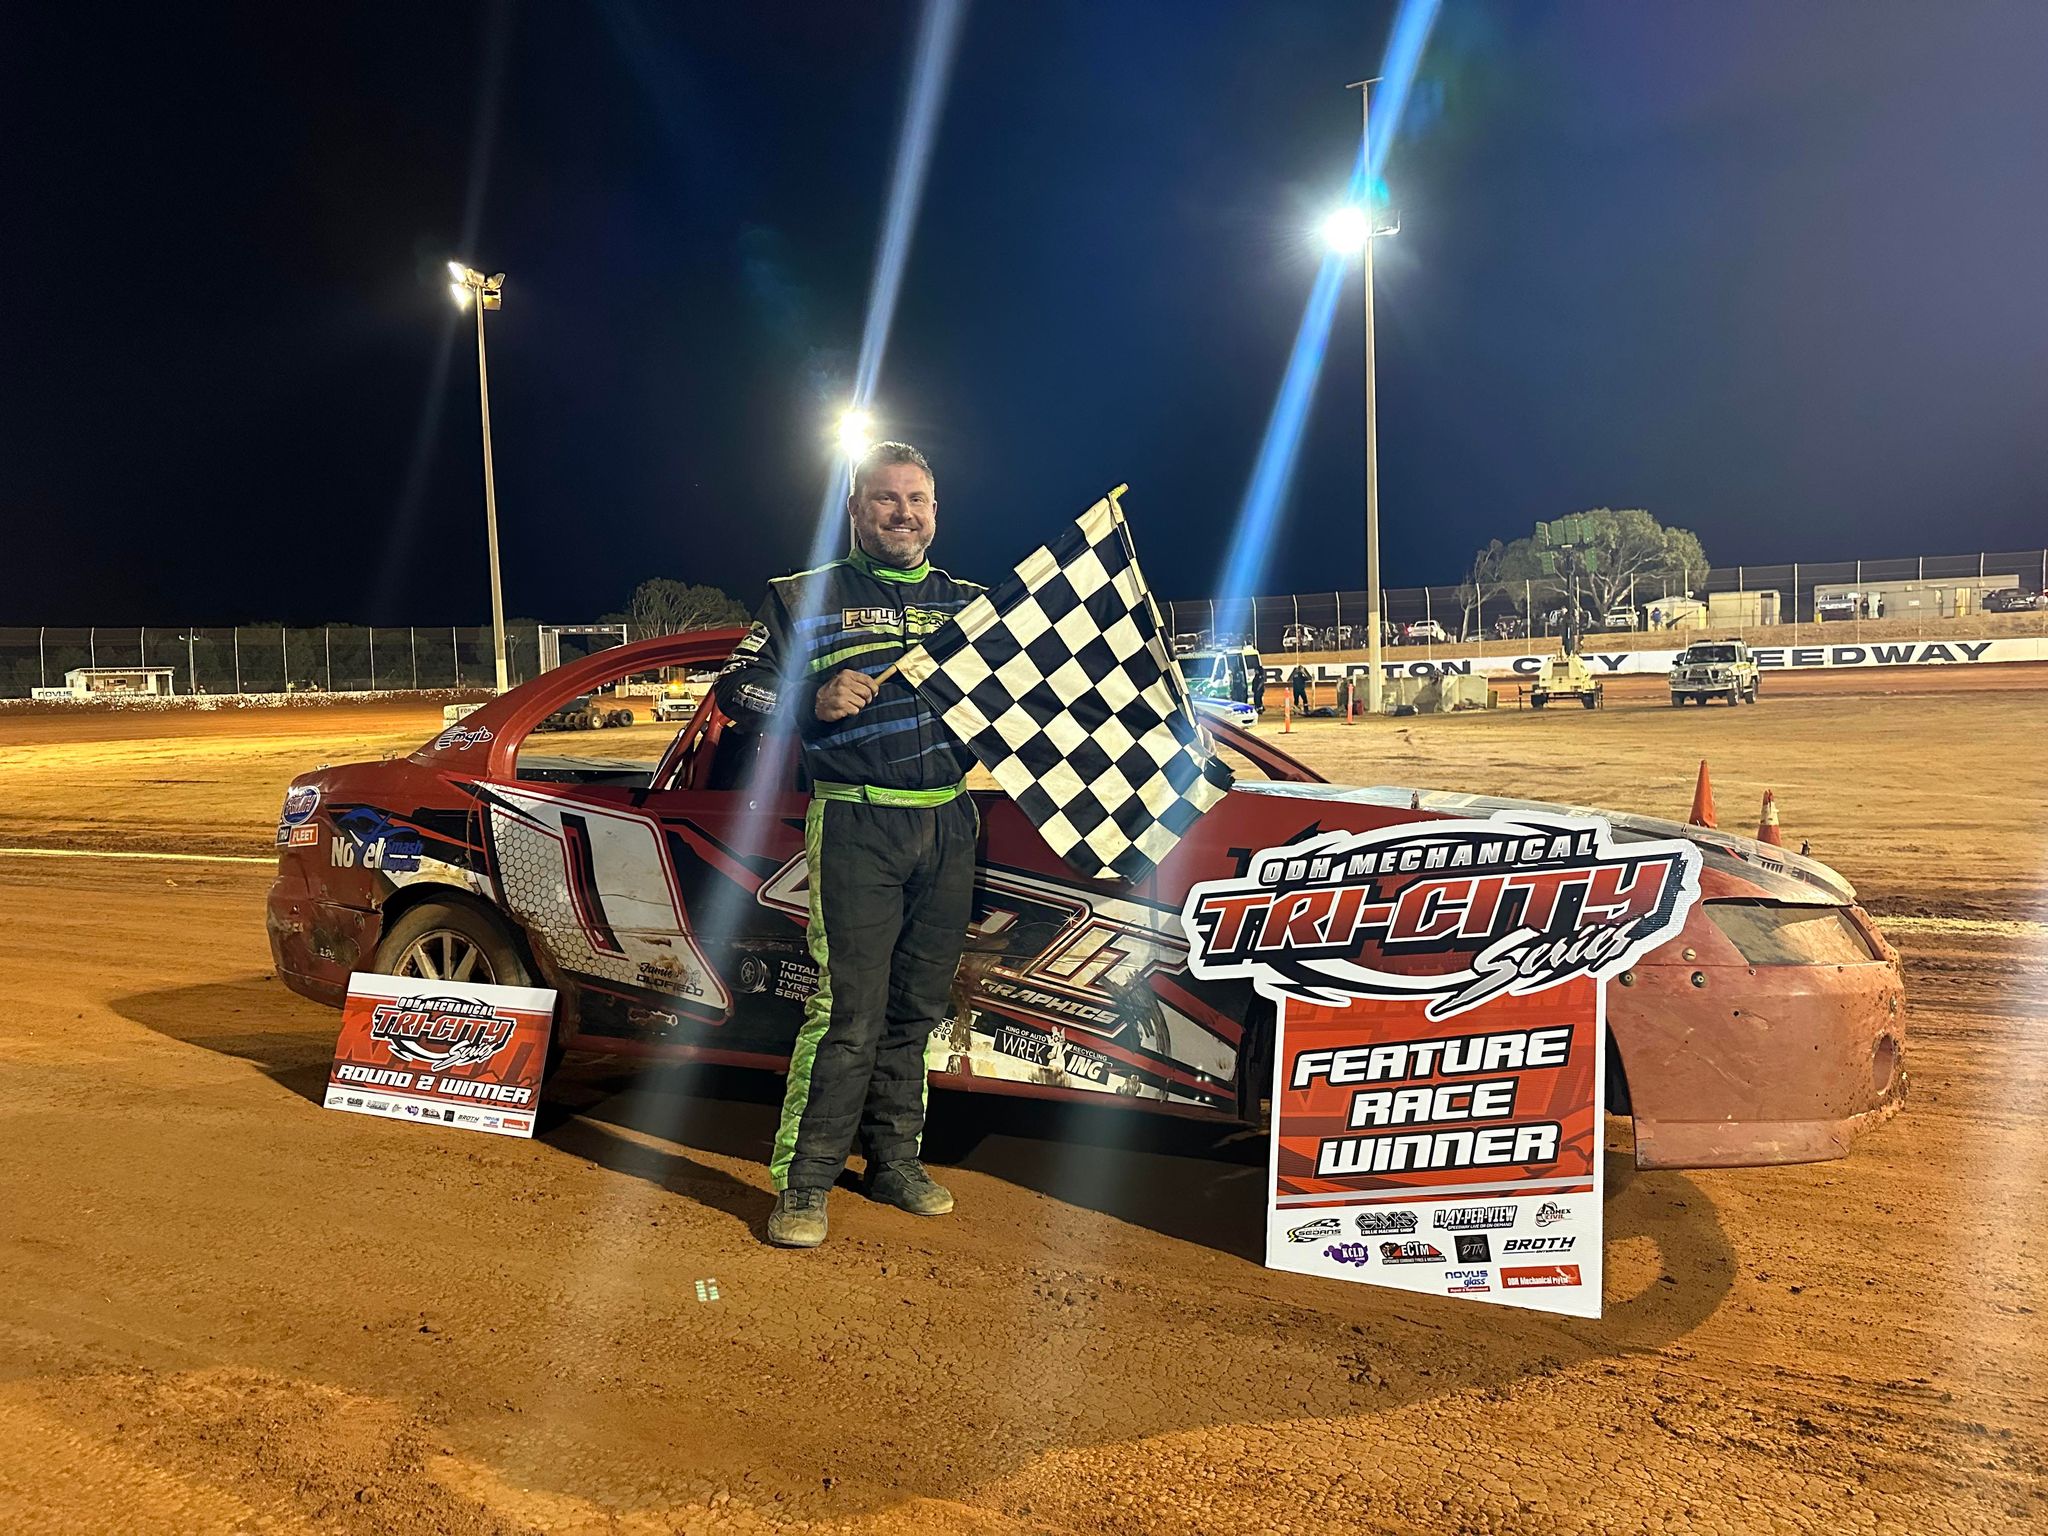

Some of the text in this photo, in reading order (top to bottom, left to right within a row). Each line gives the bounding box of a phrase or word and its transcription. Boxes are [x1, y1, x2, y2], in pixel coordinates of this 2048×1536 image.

[843, 607, 902, 628] FULL
[1512, 654, 1629, 674] CY
[292, 829, 315, 843] FLEET
[1262, 853, 1334, 884] ODH
[1347, 834, 1595, 876] MECHANICAL
[1201, 858, 1677, 955] TRI-CITY
[780, 960, 818, 976] TOTAL
[1440, 920, 1646, 1010] Series
[636, 974, 704, 997] OLDFIELD
[777, 979, 810, 993] TYRE
[780, 970, 818, 984] INDEP
[774, 987, 808, 1002] SERV
[979, 978, 1121, 1025] GRAPHICS
[423, 1000, 495, 1016] MECHANICAL
[374, 1008, 515, 1044] TRI-CITY
[432, 1038, 498, 1071] Series
[1005, 1025, 1108, 1061] KING OF AUTO RECYCLING
[1003, 1032, 1104, 1080] WREK ING
[1293, 1028, 1570, 1087] FEATURE
[336, 1064, 532, 1104] ROUND 2 WINNER
[1350, 1081, 1515, 1128] RACE
[1317, 1124, 1559, 1176] WINNER
[1434, 1205, 1517, 1227] CLAY-PER-VIEW
[1503, 1237, 1577, 1251] BROTH
[1463, 1277, 1486, 1288] glass
[1520, 1276, 1552, 1285] Mechanical
